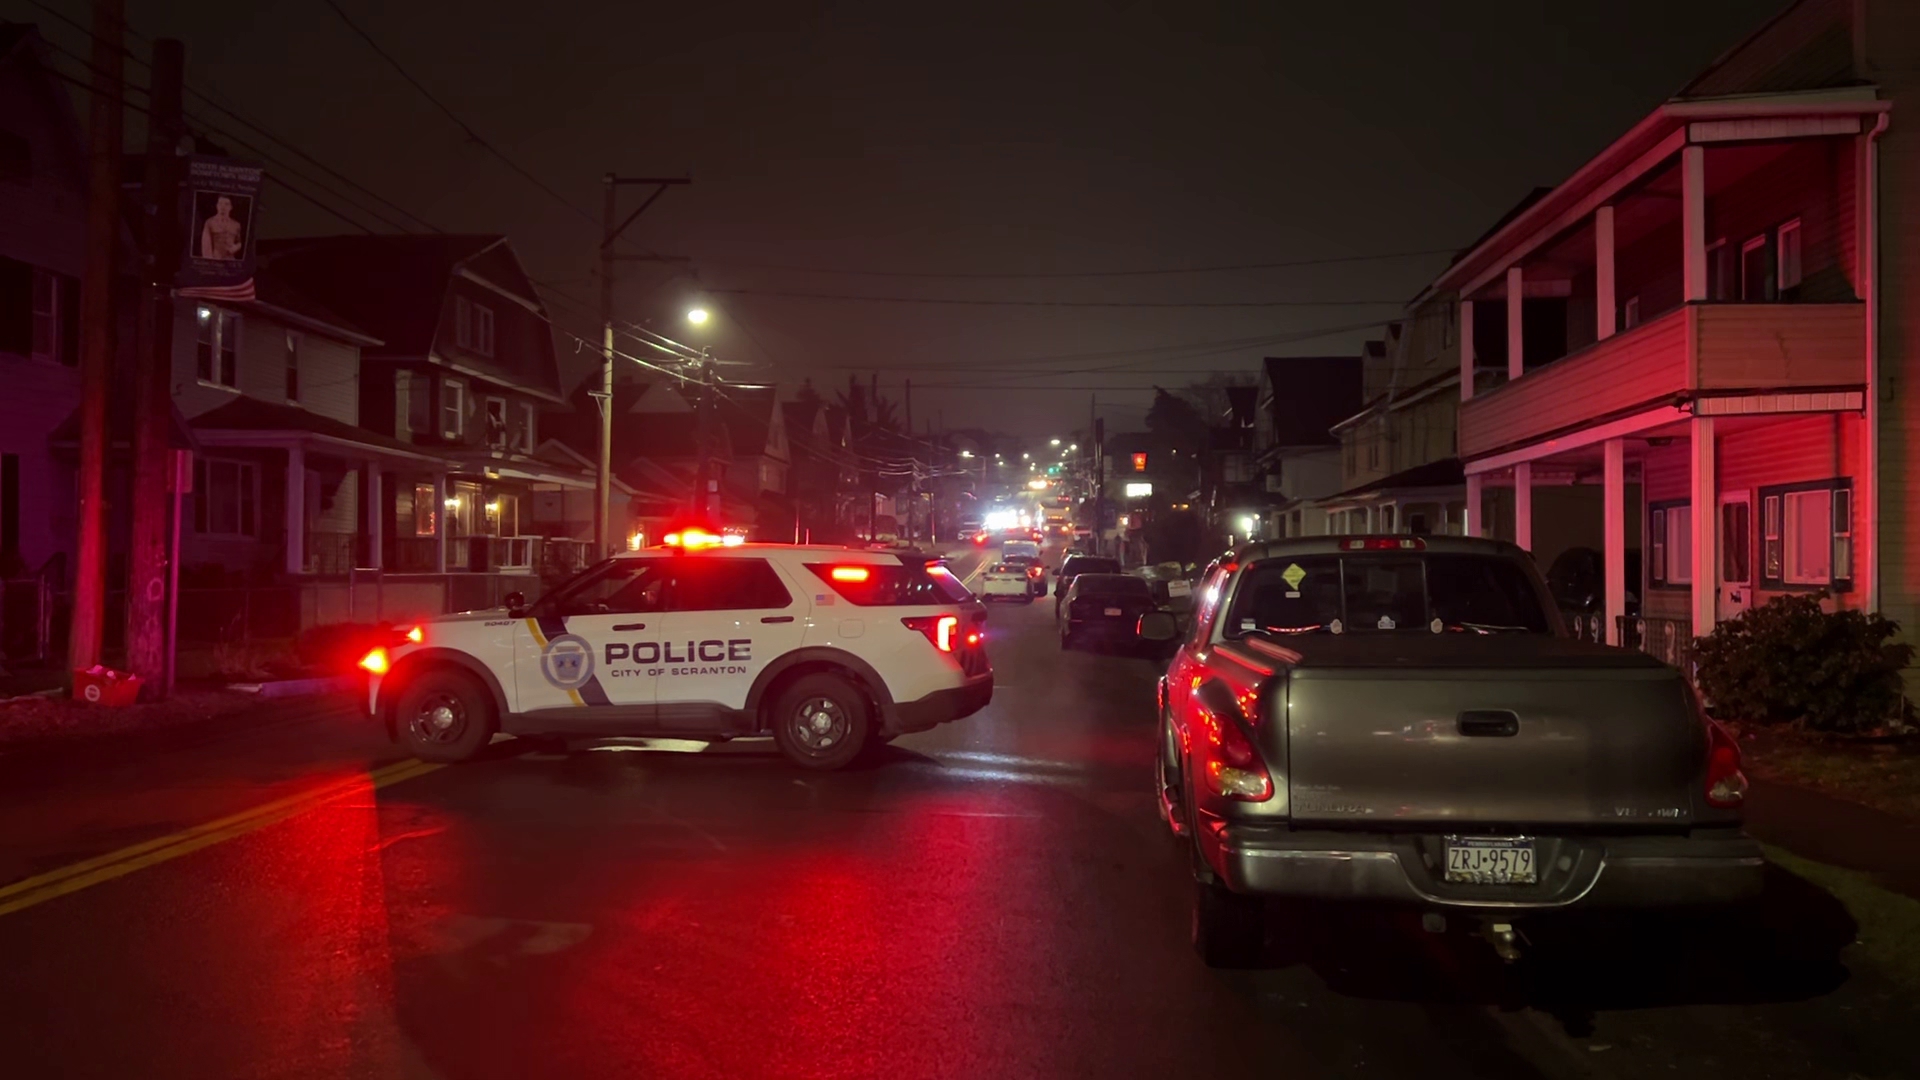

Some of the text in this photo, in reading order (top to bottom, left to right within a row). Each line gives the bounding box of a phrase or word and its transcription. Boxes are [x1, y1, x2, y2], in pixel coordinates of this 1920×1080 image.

[605, 639, 752, 665] POLICE
[611, 666, 747, 678] CITY OF SCRANTON
